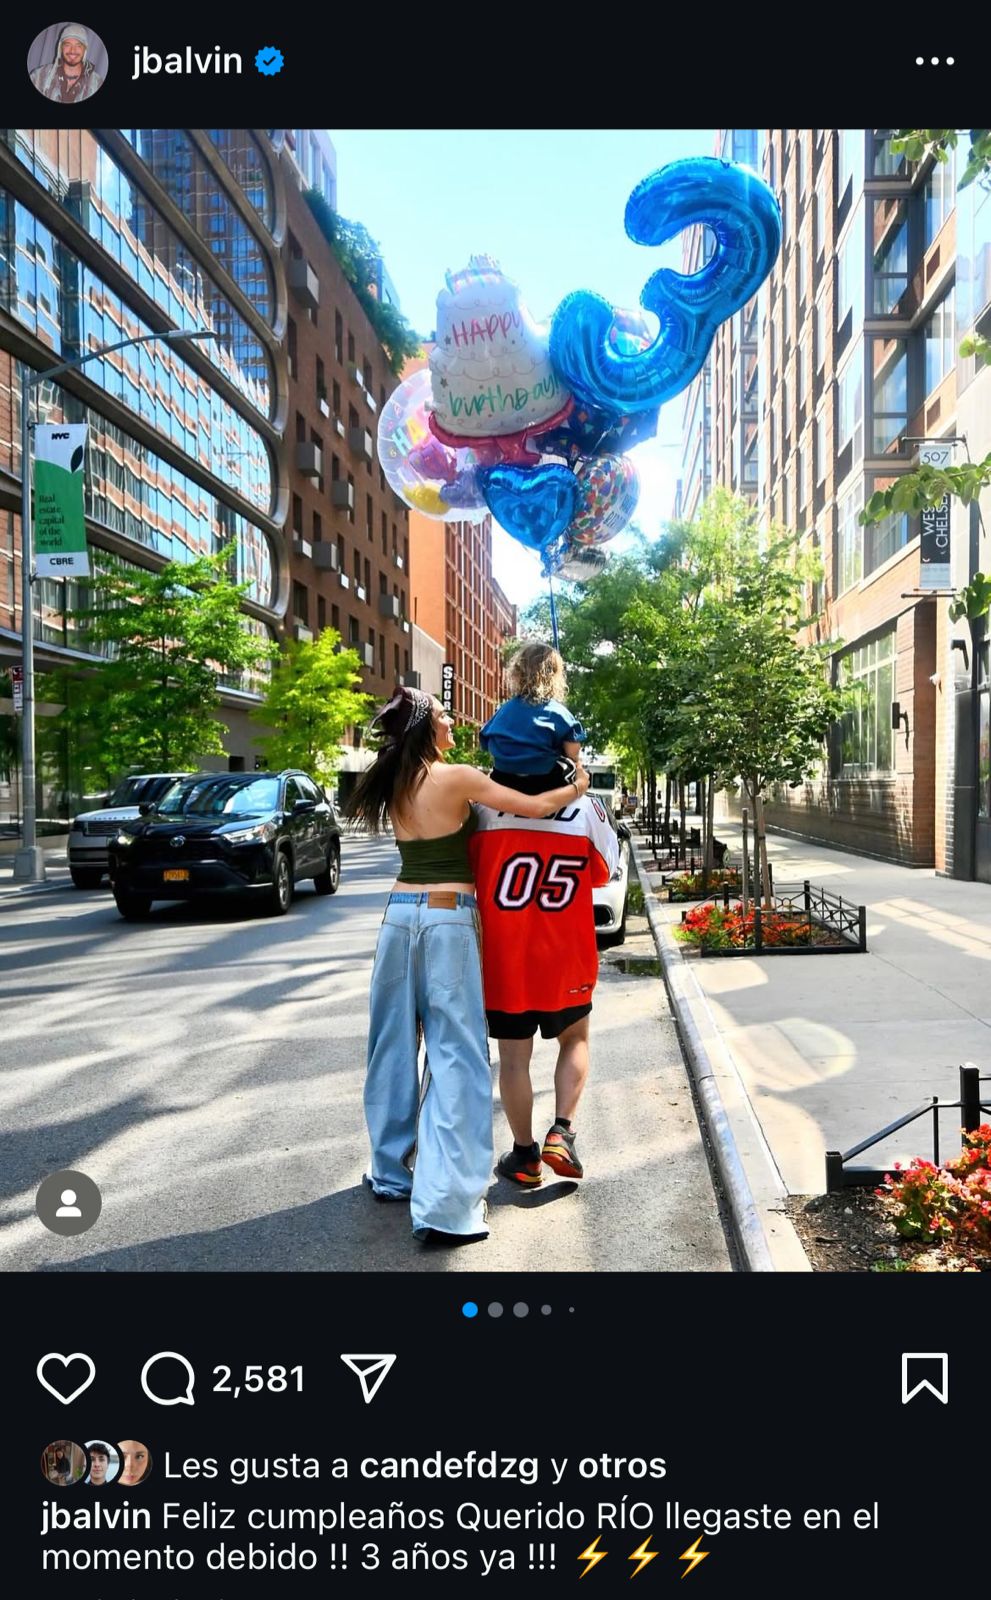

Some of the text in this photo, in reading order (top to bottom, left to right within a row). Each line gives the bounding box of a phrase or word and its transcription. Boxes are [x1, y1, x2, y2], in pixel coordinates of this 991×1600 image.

[51, 432, 70, 440] NYC
[922, 451, 949, 464] 507
[39, 515, 65, 526] capital
[40, 537, 62, 546] world
[49, 557, 74, 565] CBRE
[495, 852, 588, 912] 05
